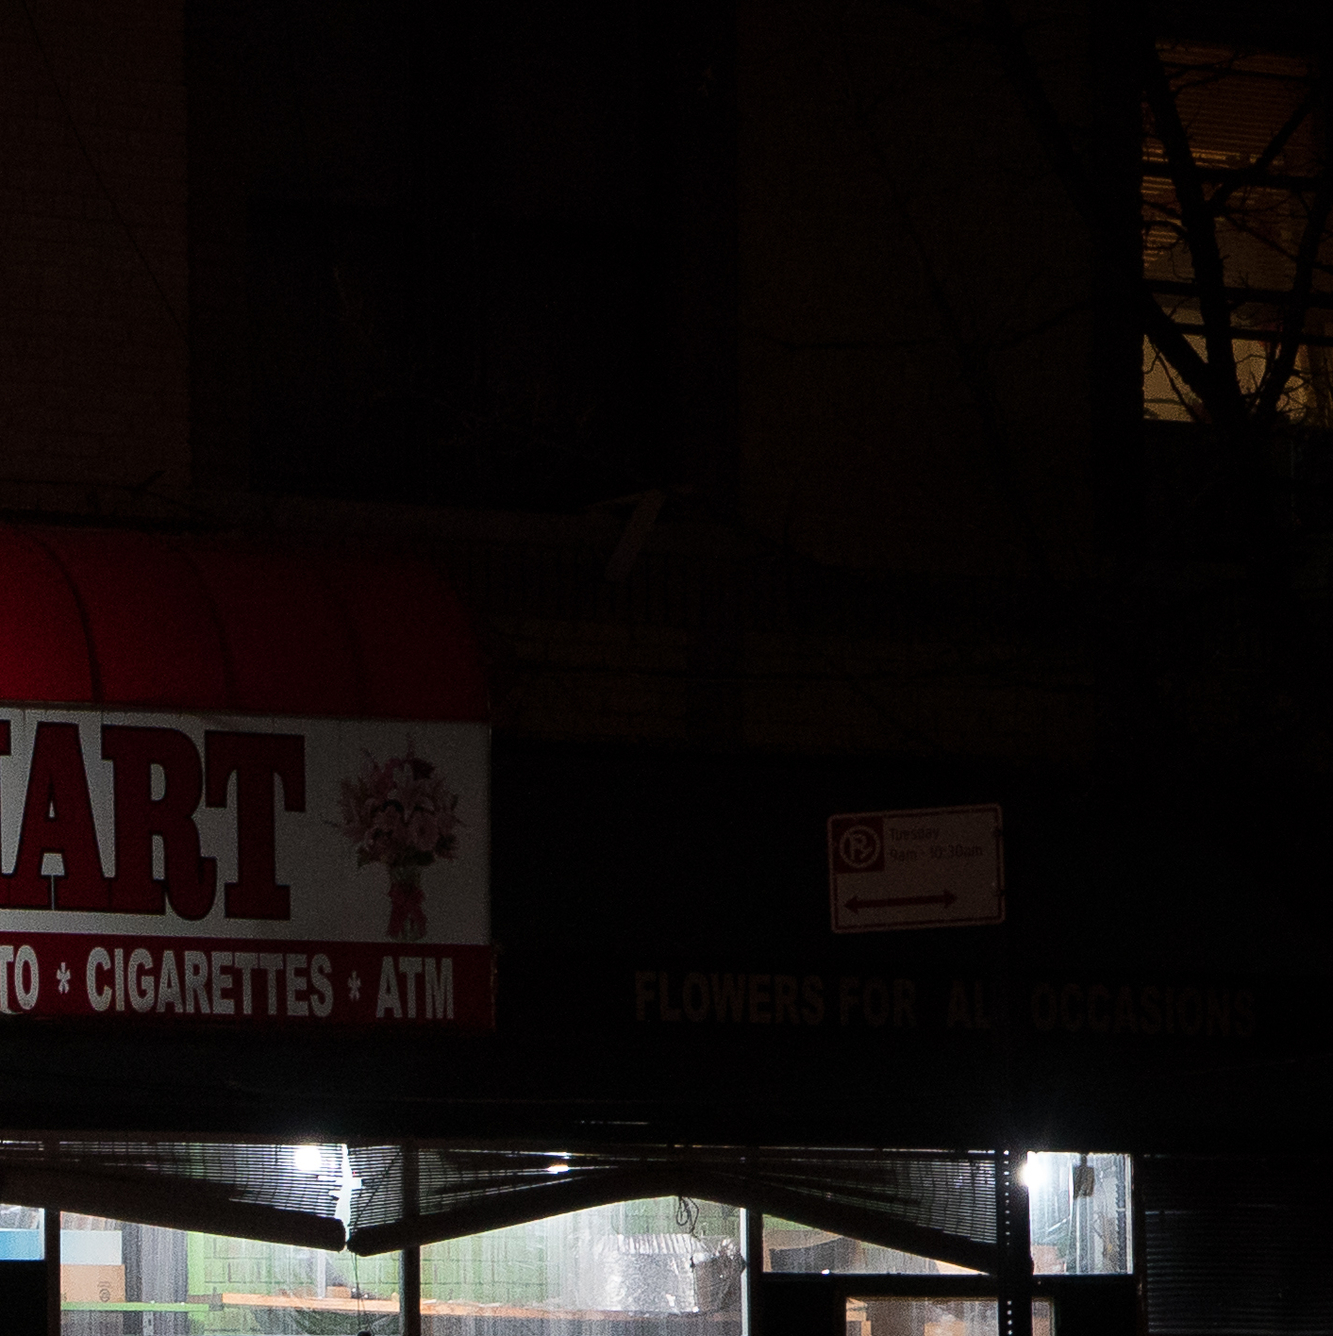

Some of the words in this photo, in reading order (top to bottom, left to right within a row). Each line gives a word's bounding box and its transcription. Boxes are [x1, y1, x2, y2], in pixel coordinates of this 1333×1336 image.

[889, 826, 941, 842] Tuesday
[85, 947, 334, 1019] CIGARETTES
[375, 955, 455, 1021] ATM
[632, 969, 826, 1028] FLOWERS
[837, 975, 918, 1030] FOR
[946, 978, 995, 1032] AL
[1032, 980, 1256, 1040] OCCASIONS
